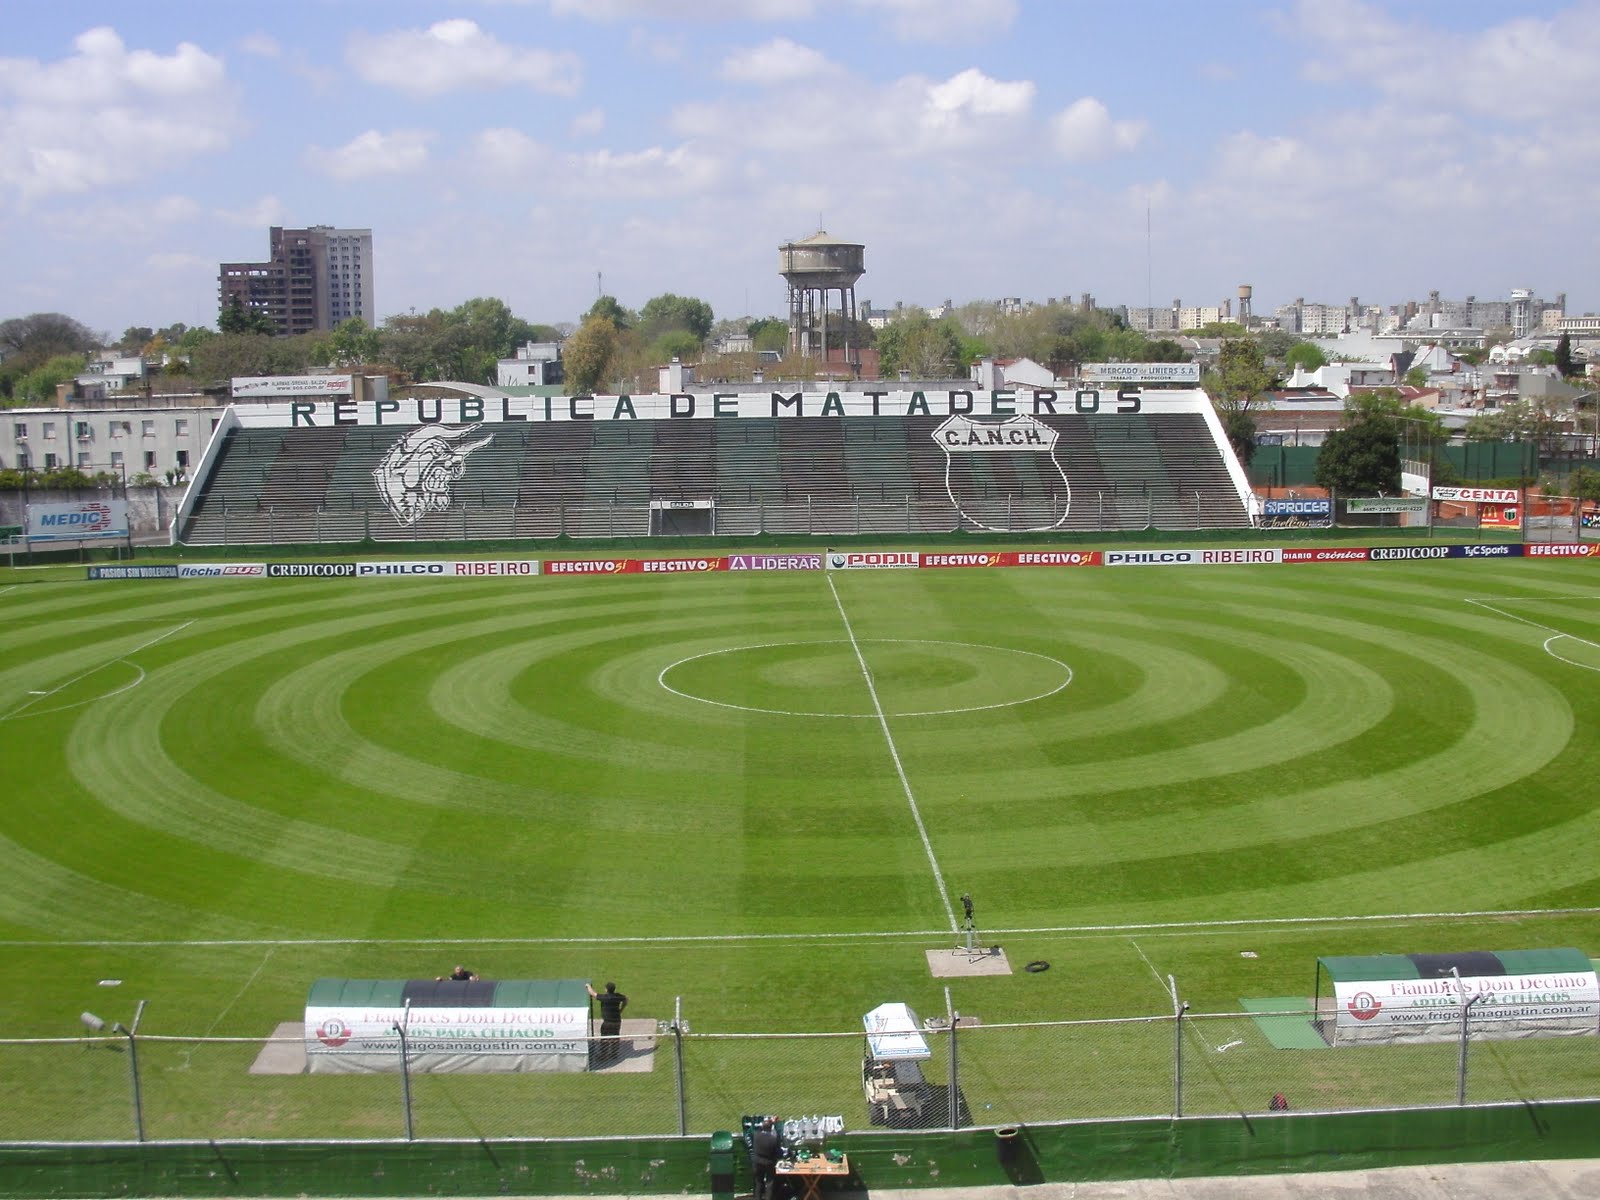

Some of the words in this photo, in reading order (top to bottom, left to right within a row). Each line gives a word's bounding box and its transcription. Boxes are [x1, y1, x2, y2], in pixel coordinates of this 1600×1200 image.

[1100, 367, 1138, 375] MERCADO
[292, 394, 638, 427] REPUBLICA
[670, 393, 740, 420] DE
[771, 390, 1142, 418] MATADEROS
[1459, 489, 1516, 501] CENTA
[1277, 501, 1330, 513] PROCER
[41, 512, 101, 526] MEDIC
[1282, 552, 1312, 560] DIARIO
[1370, 546, 1449, 560] CREDICOOP
[1529, 545, 1589, 555] EFECTIVO
[847, 553, 919, 565] PODIL
[925, 554, 987, 566] EFECTIVO
[1018, 553, 1081, 565] EFECTIVO
[1109, 552, 1192, 563] PHILCO
[1202, 550, 1275, 563] RIBEIRO
[455, 562, 531, 575] RIBEIRO
[551, 561, 615, 573] EFECTIVO
[643, 560, 707, 572] EFECTIVO
[751, 556, 821, 570] LIDERAR
[100, 566, 126, 578] PASION
[127, 566, 140, 578] SIN
[140, 565, 177, 577] VIOLENCIA
[181, 566, 221, 577] flecha
[224, 566, 264, 576] BUS
[270, 564, 354, 577] CREDICOOP
[359, 564, 444, 575] PHILCO
[1479, 979, 1514, 992] Don
[1520, 975, 1588, 990] Decimo
[1390, 1005, 1591, 1021] www.frigoanagustin.com.ar
[362, 1041, 577, 1052] www.rigosanagustin.com.ar
